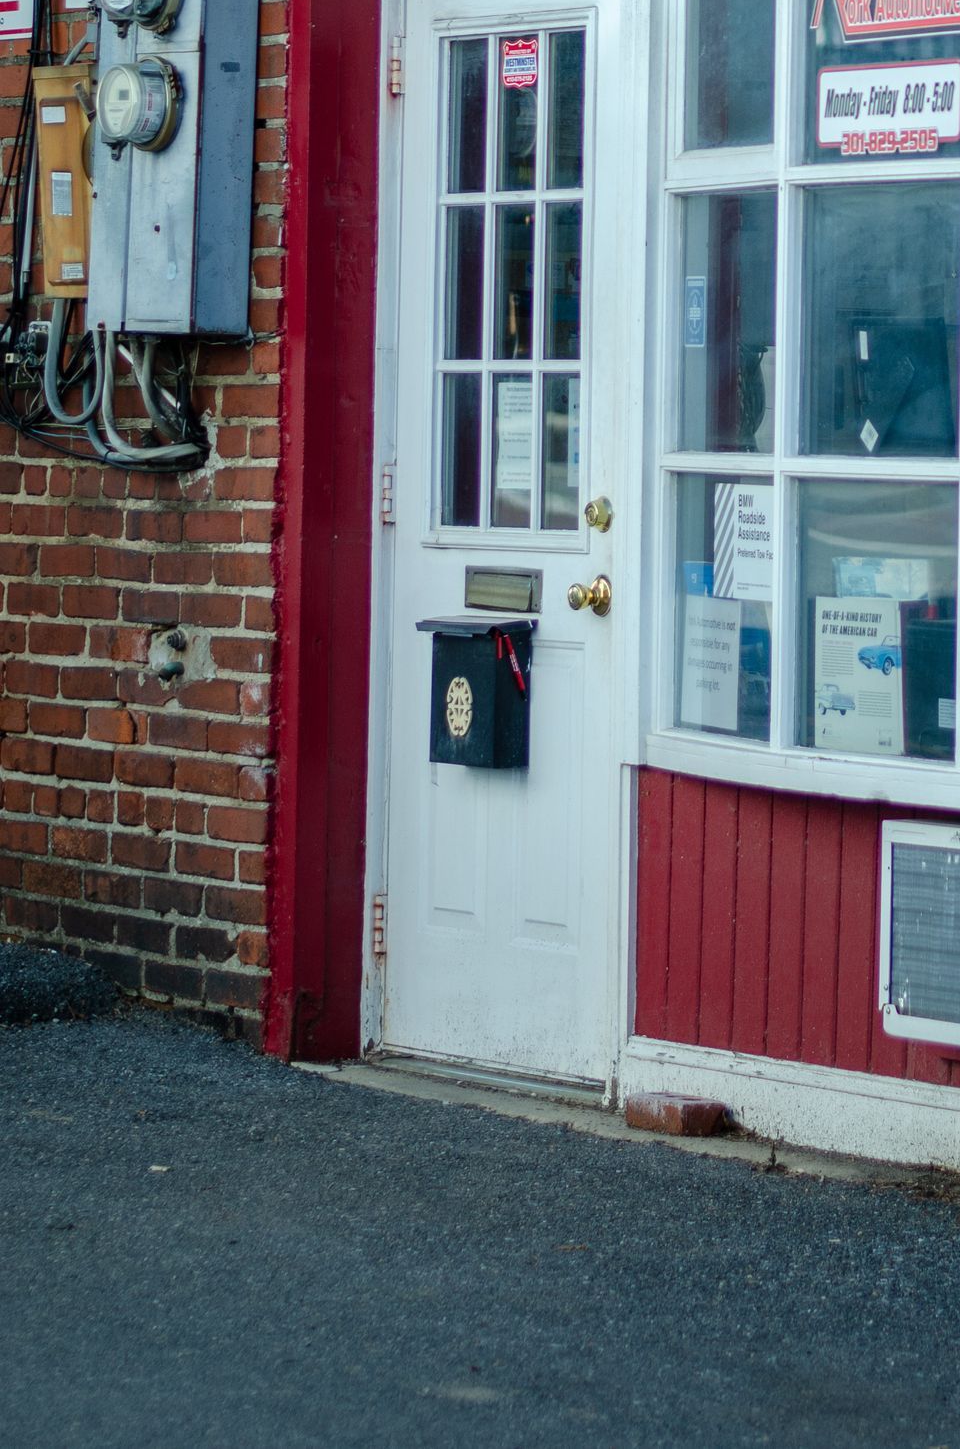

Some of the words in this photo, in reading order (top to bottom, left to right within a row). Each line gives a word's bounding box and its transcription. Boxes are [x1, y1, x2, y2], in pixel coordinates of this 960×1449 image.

[824, 88, 863, 120] Monday
[868, 85, 899, 117] Friday
[903, 82, 926, 114] 8:00
[932, 80, 955, 112] 5:00
[841, 129, 937, 154] 301-829-2505
[738, 494, 754, 508] BMW
[738, 510, 766, 525] Roadside
[737, 527, 770, 542] Assistance
[822, 610, 859, 622] ONE-OF-A-KIND
[860, 612, 882, 624] HISTORY
[829, 624, 838, 635] THE
[840, 625, 866, 637] AMERICAN
[867, 627, 878, 638] CAR
